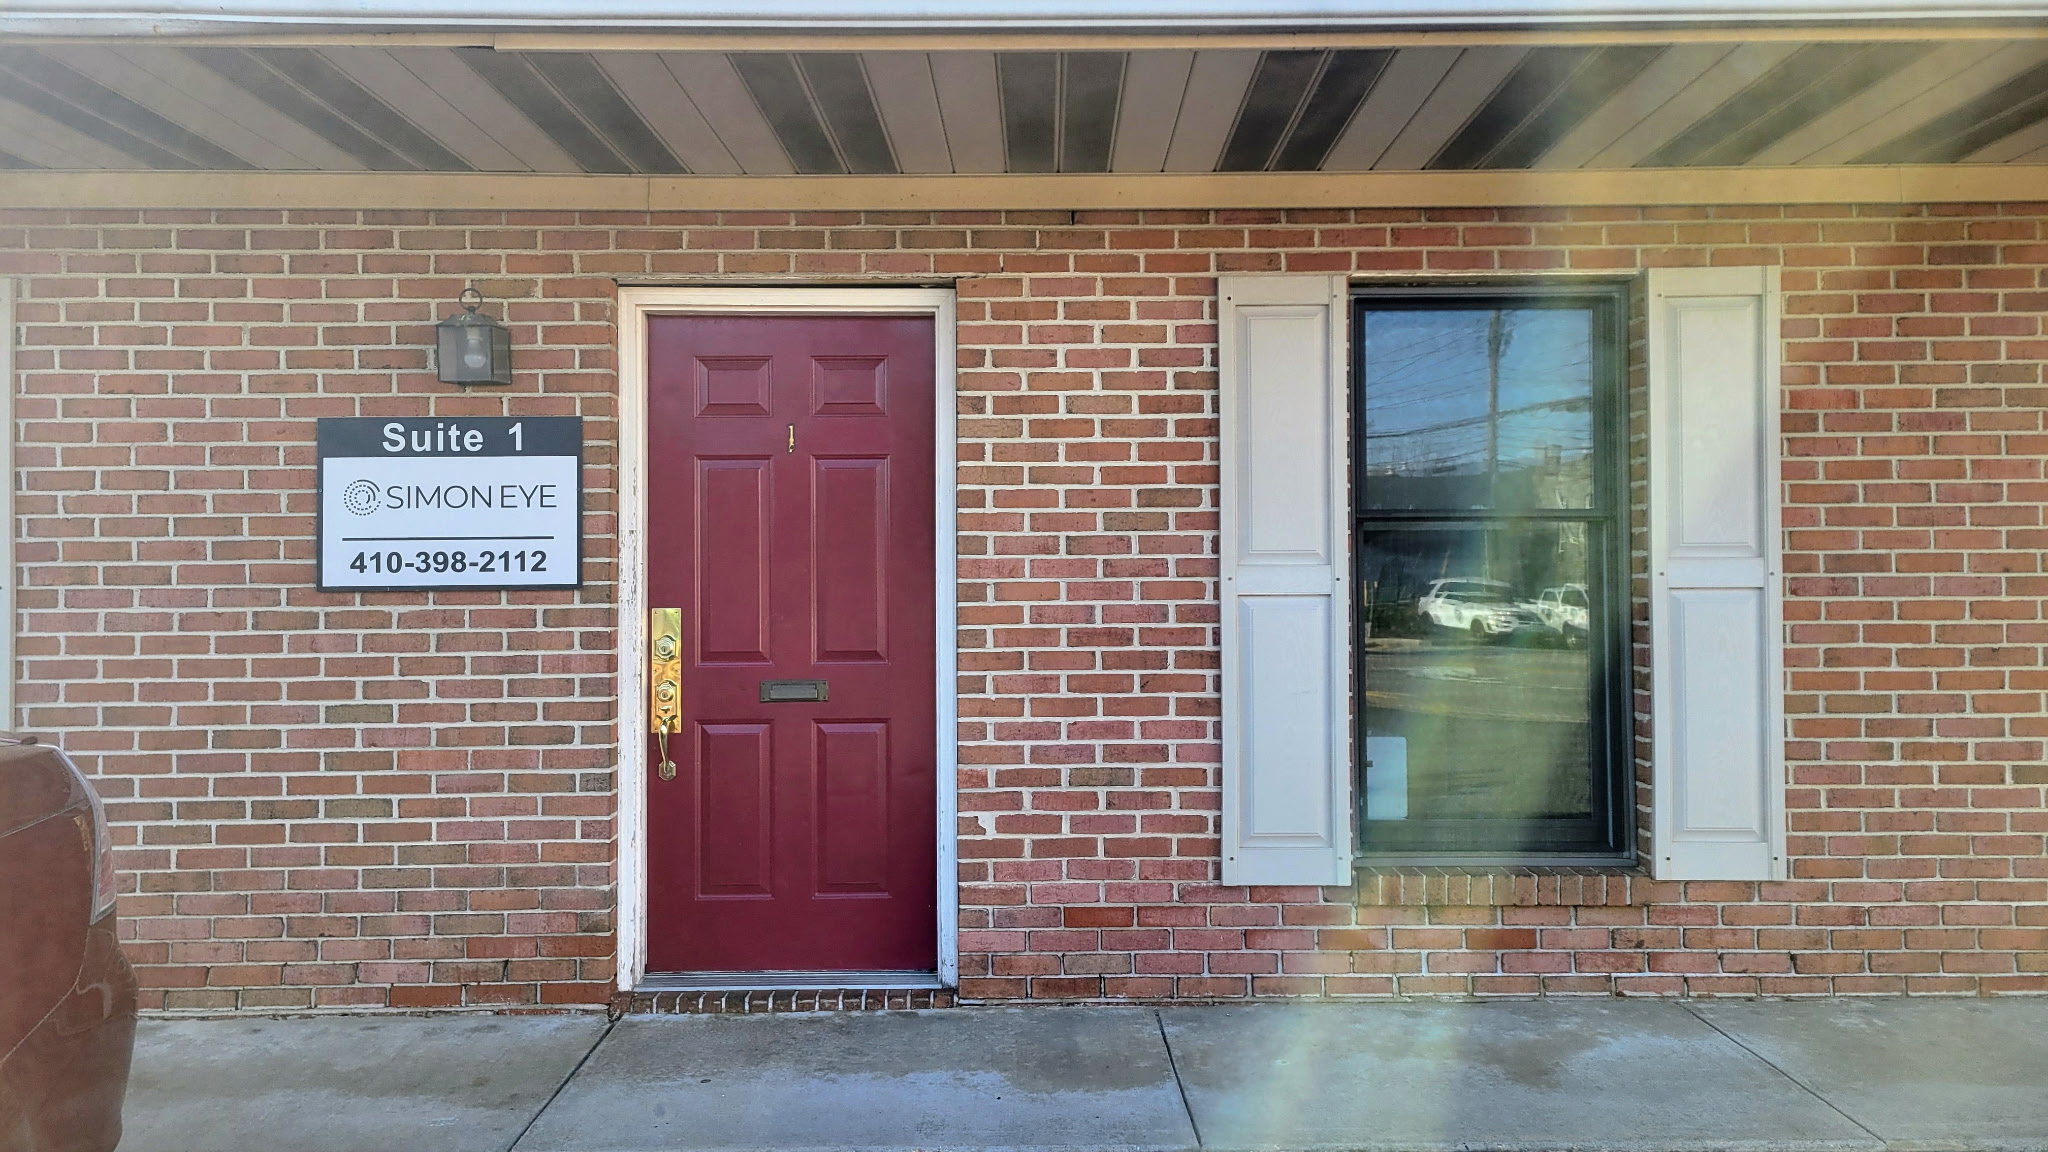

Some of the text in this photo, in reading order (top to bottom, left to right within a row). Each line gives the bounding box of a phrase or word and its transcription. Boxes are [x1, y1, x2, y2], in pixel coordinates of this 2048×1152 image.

[382, 422, 523, 452] Suite 1
[386, 484, 557, 509] SIMON EYE
[350, 550, 547, 574] 410-398-2112
